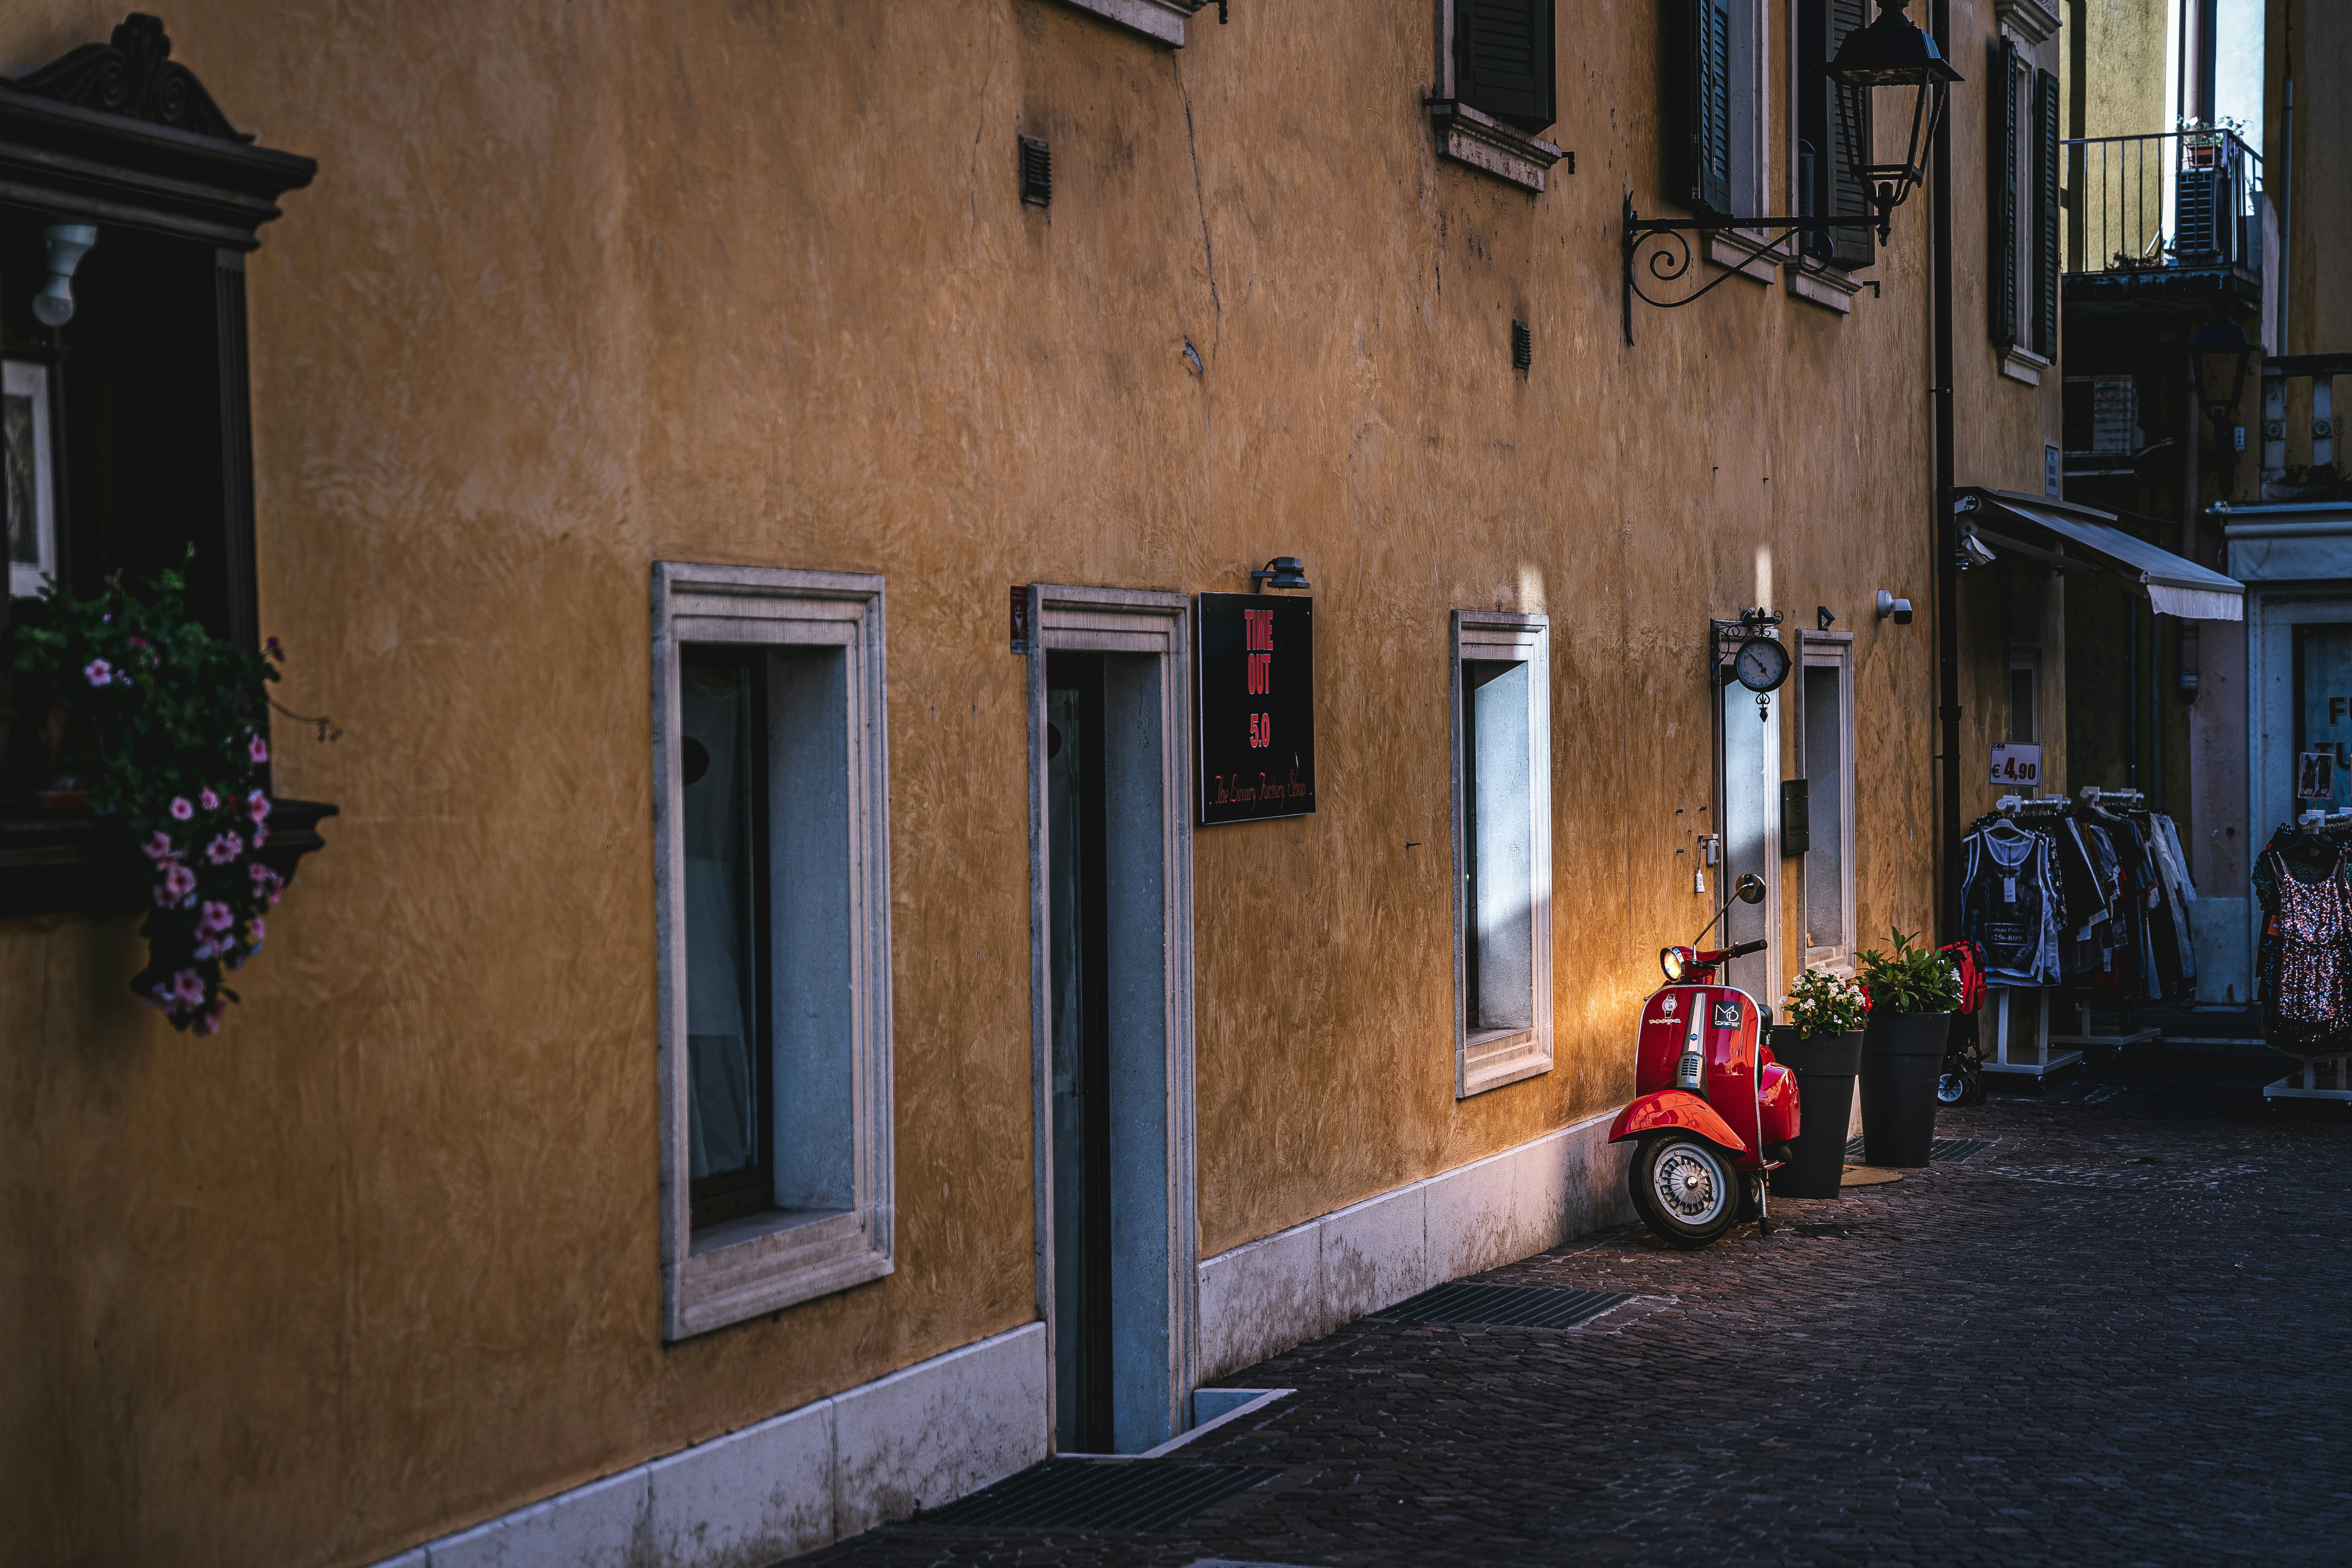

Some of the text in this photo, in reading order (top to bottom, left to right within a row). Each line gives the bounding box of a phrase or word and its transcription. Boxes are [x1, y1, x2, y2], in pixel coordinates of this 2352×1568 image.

[1245, 609, 1273, 650] TIME
[1248, 653, 1271, 694] OUT
[1250, 713, 1270, 747] 5.0
[1215, 768, 1306, 810] The Luxury Factory Shop
[1991, 757, 2037, 782] € 4,90
